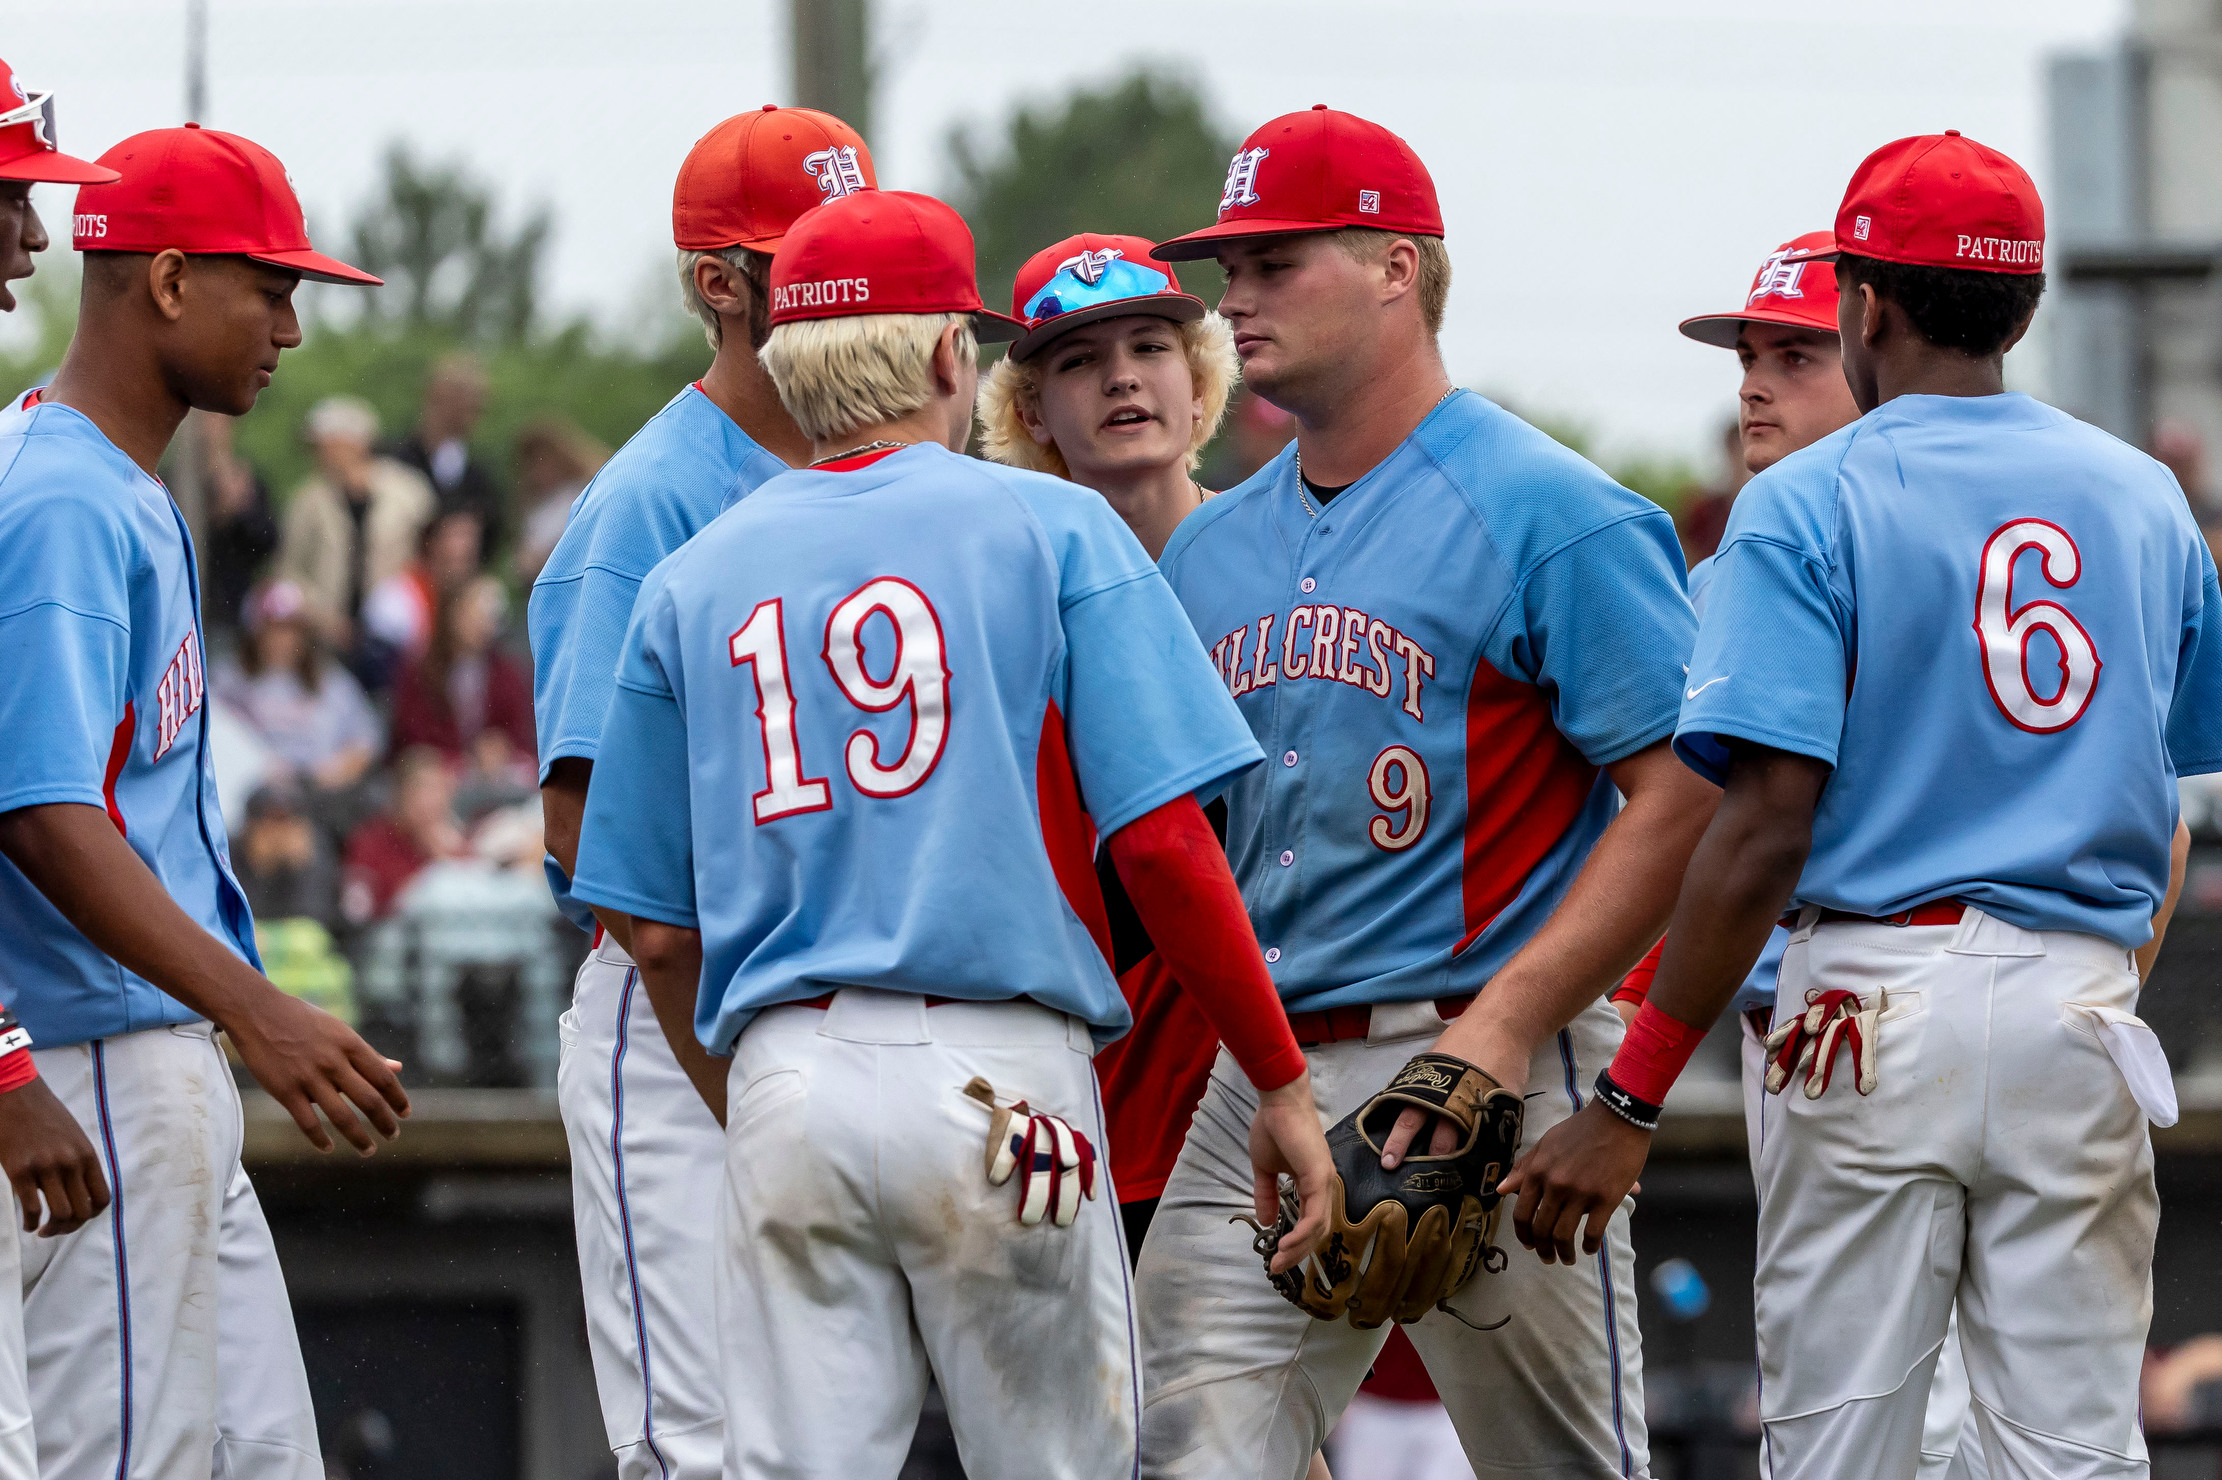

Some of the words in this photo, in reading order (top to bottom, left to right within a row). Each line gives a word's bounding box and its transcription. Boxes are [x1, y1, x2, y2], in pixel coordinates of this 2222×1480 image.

[73, 214, 108, 238] IOTS
[1218, 146, 1269, 220] H
[773, 277, 871, 311] PATRIOTS
[1956, 234, 2042, 263] PATRIOTS
[1208, 604, 1436, 724] ILLCREST
[1972, 517, 2103, 735] 6
[728, 575, 954, 827] 19
[1366, 744, 1434, 853] 9
